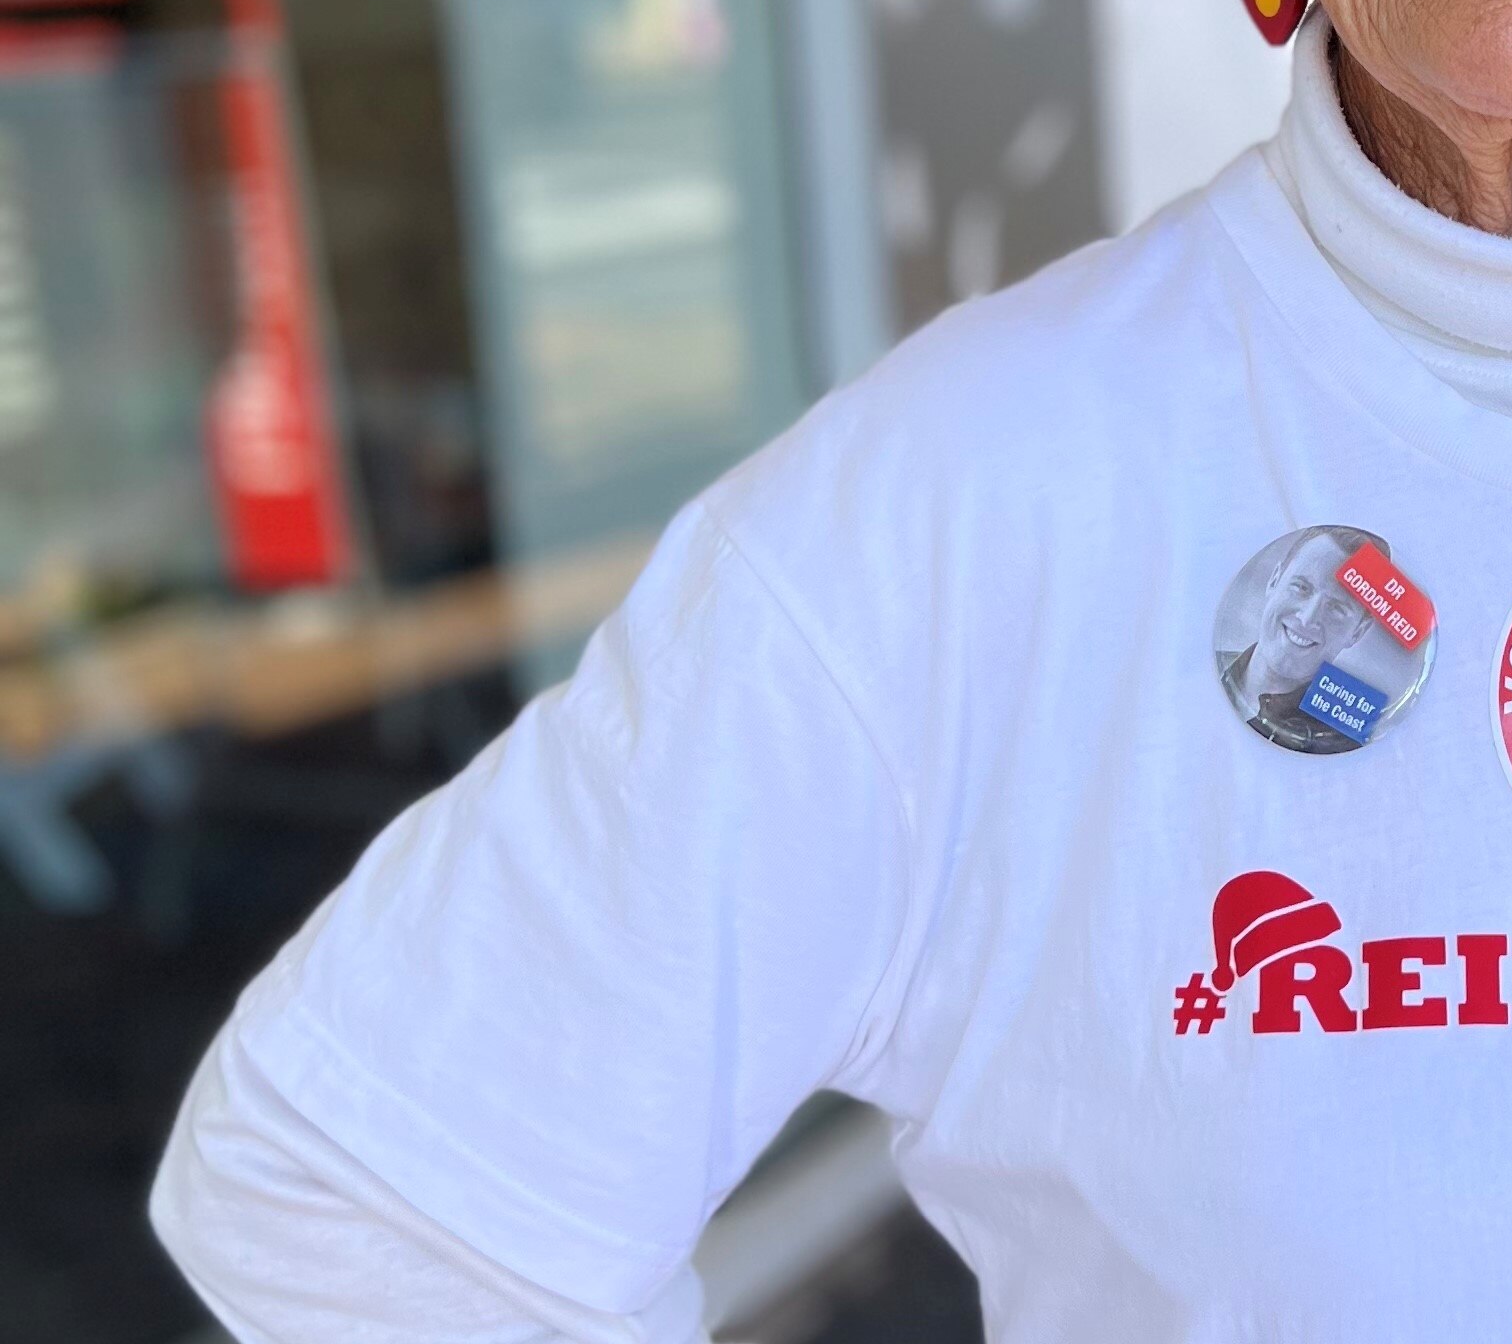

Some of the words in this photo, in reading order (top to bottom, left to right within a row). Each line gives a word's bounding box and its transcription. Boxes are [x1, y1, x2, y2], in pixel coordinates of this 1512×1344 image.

[1343, 567, 1391, 616] GORDON
[1386, 608, 1418, 643] REID
[1383, 576, 1406, 601] DR
[1310, 692, 1331, 713] the
[1330, 702, 1366, 733] Coast
[1318, 675, 1358, 708] Caring
[1356, 693, 1377, 716] for
